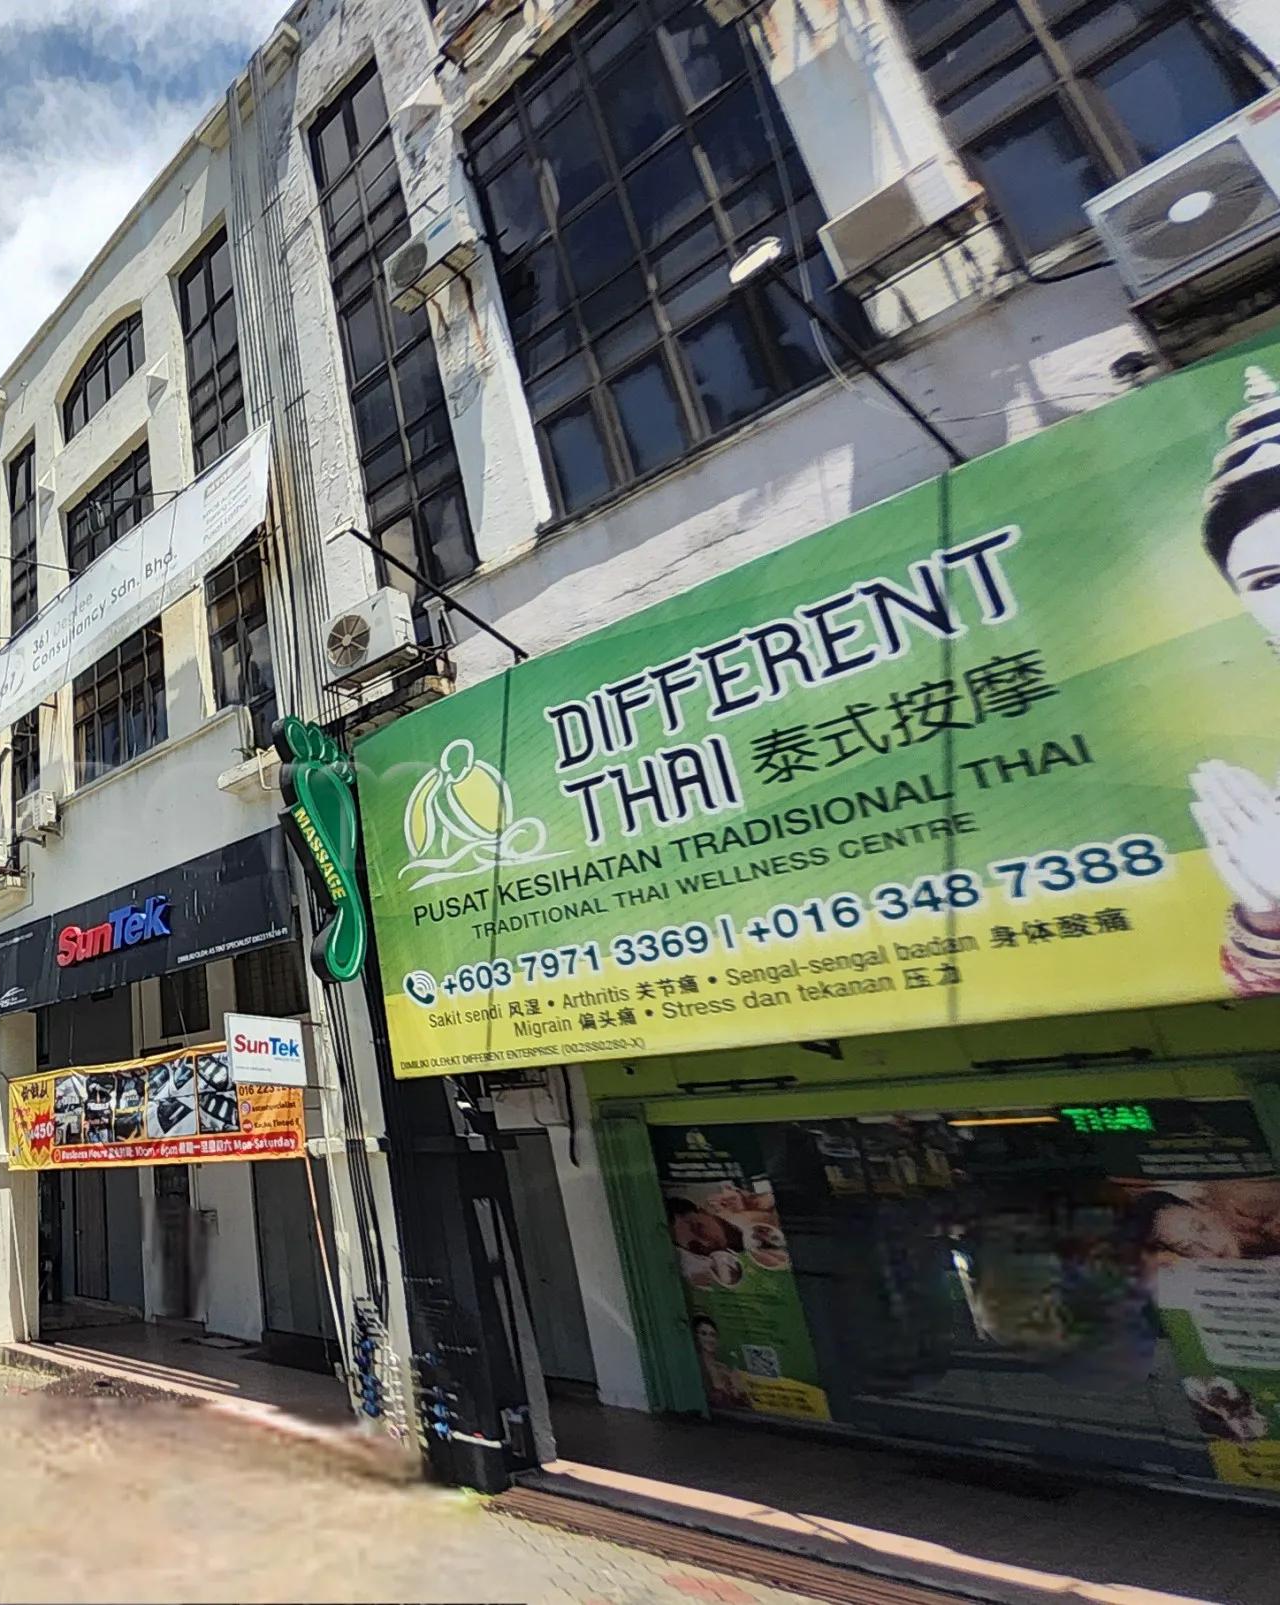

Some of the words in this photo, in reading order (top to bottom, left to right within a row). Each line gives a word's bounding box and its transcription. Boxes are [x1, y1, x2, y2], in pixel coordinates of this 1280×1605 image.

[32, 600, 107, 672] Consultancy
[110, 577, 141, 603] Sdn.
[145, 550, 178, 579] Bhd.
[545, 530, 1016, 772] DIFFERENT
[752, 649, 1060, 788] 泰式按摩
[565, 738, 739, 844] THAI
[293, 805, 347, 901] MASSAGE
[413, 888, 489, 926] PUSAT
[496, 846, 662, 908] KESIHATAN
[674, 773, 956, 865] TRADISIONAL
[959, 733, 1094, 790] THAI
[472, 898, 608, 940] TRADITIONAL
[613, 882, 671, 908] THAI
[676, 847, 830, 893] WELLNESS
[843, 812, 978, 860] CENTRE
[748, 896, 862, 945] +016
[875, 873, 980, 922] 348
[997, 838, 1167, 900] 7388
[57, 894, 172, 968] SunTek
[990, 906, 1135, 950] 身体酸痛
[443, 962, 512, 996] +603
[521, 943, 601, 983] 7971
[614, 924, 709, 967] 3369
[635, 974, 700, 1000] 关节痛
[726, 945, 889, 987] Sengal-sengal
[896, 933, 981, 963] badan
[902, 963, 964, 992] 压力
[428, 1005, 462, 1030] Sakit
[465, 1002, 503, 1025] sendi
[562, 988, 631, 1011] Arthritis
[578, 1007, 639, 1033] 偏头痛
[662, 993, 737, 1020] Stress
[742, 984, 792, 1011] dan
[796, 972, 896, 1003] tekanan
[233, 1033, 300, 1058] SunTek
[506, 1044, 560, 1062] ENTERPRISE
[513, 1015, 573, 1041] Migrain
